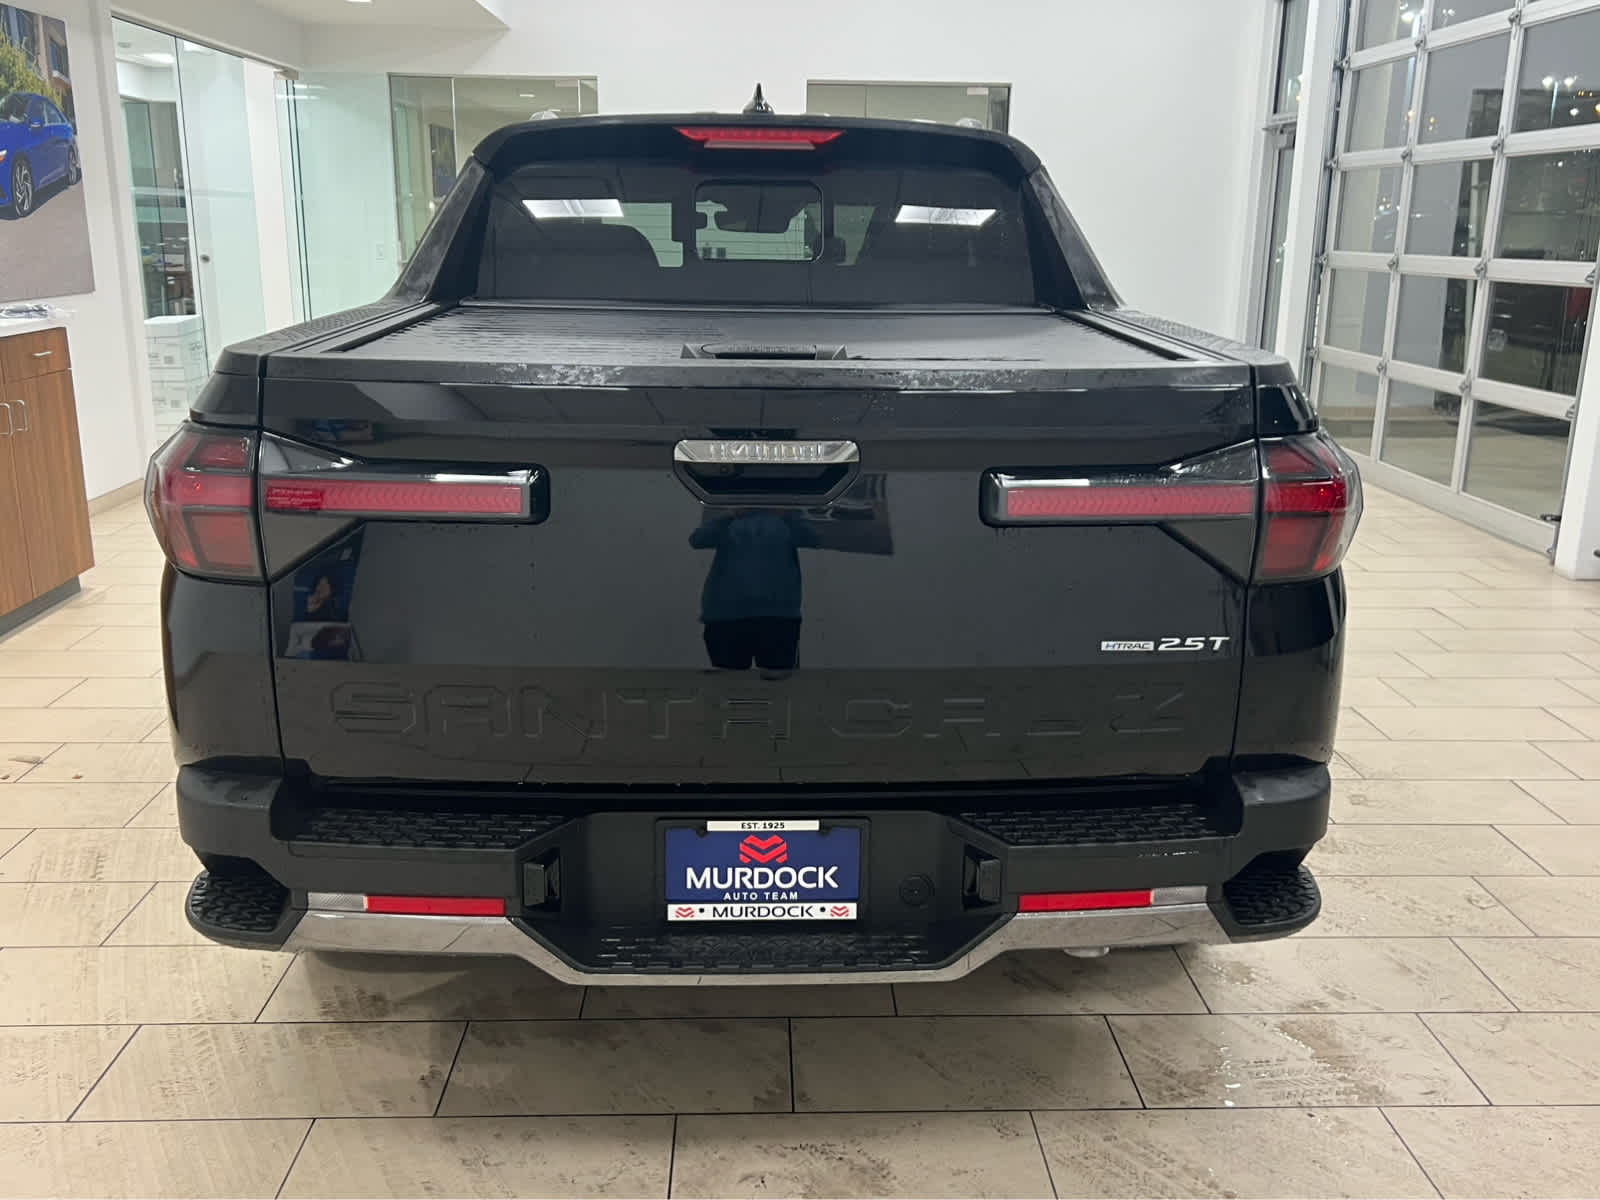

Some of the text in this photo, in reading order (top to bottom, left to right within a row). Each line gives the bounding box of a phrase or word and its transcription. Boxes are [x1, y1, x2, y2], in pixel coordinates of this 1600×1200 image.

[1105, 641, 1151, 651] HTRAC
[329, 681, 793, 742] SANTA
[763, 822, 786, 830] 1925
[686, 866, 839, 889] MURDOCK
[723, 892, 799, 901] AUTO TEAM
[712, 905, 815, 918] MURDOCK
